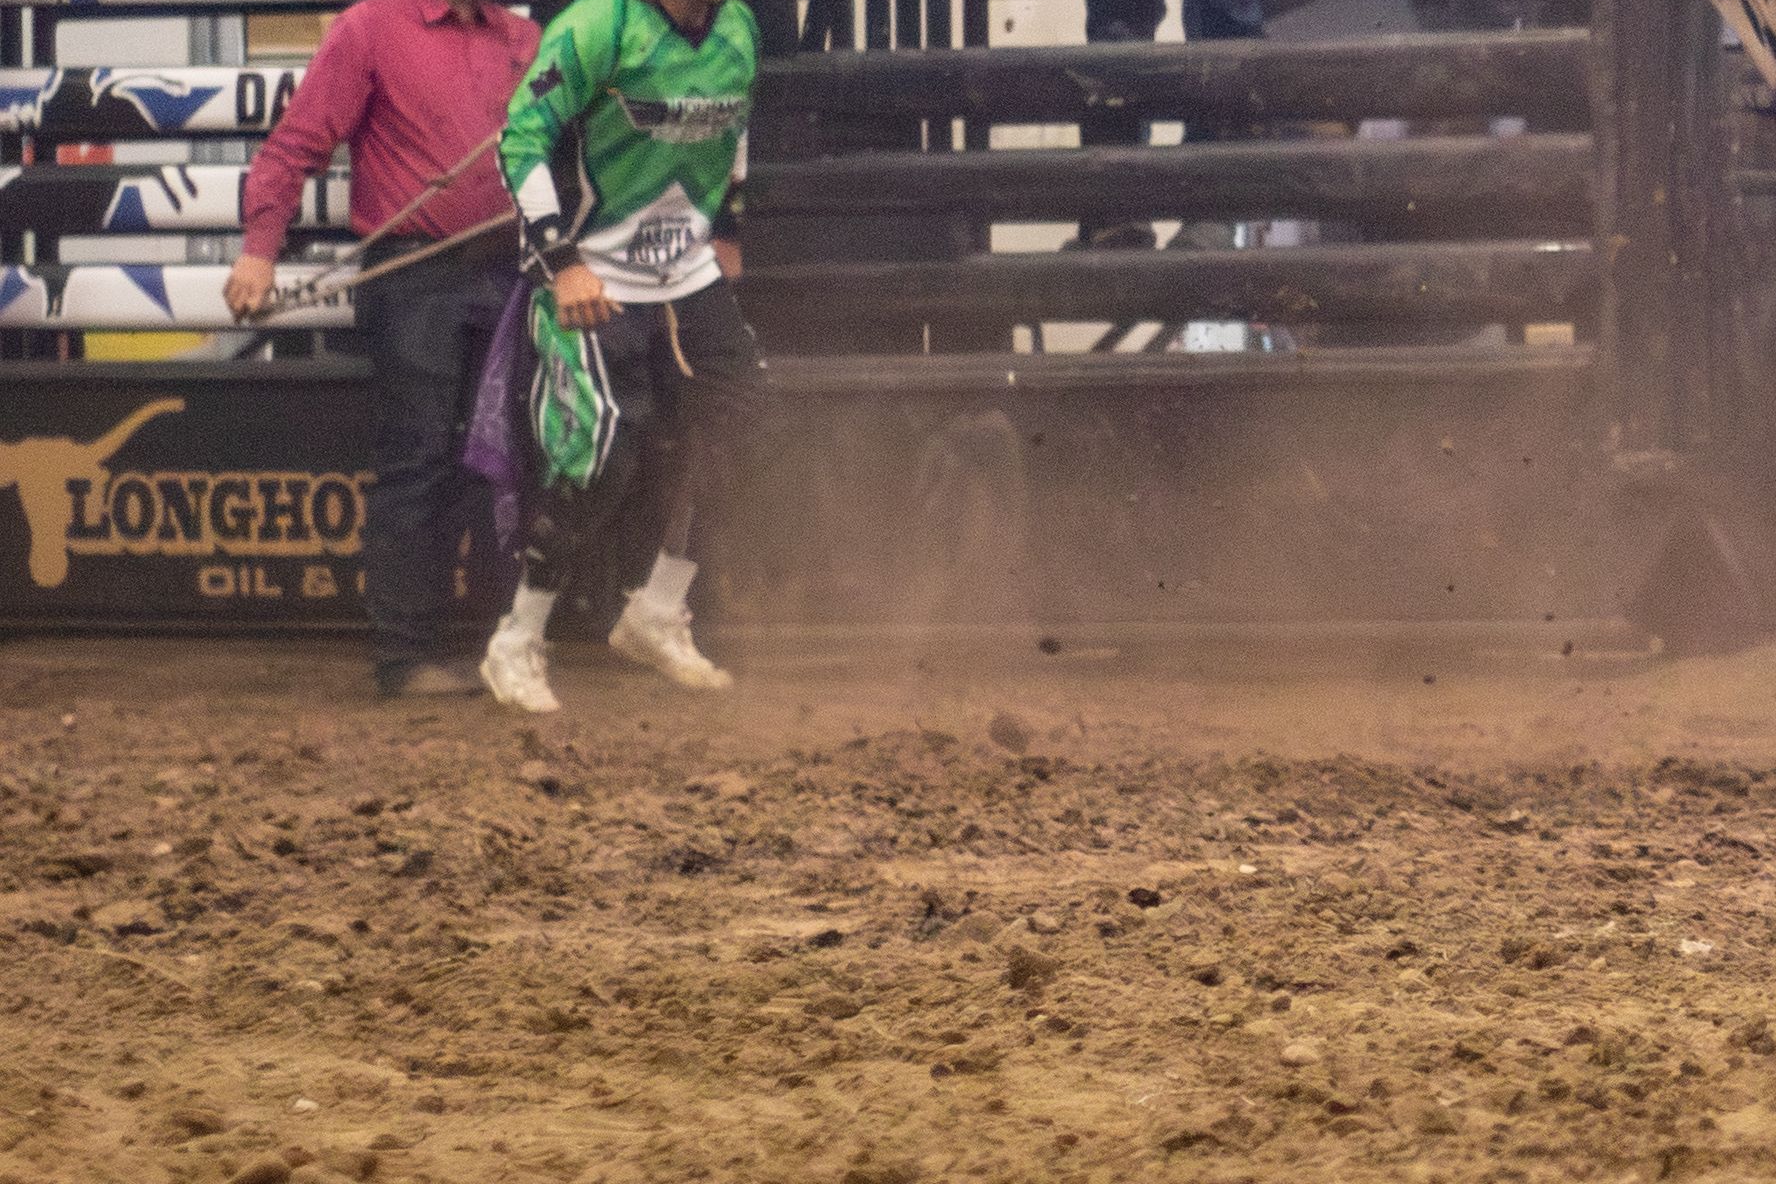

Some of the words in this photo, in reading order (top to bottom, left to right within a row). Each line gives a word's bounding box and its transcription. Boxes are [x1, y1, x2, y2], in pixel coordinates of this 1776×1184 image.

[64, 471, 372, 556] LONGHO
[198, 567, 283, 599] OIL
[303, 565, 340, 599] &
